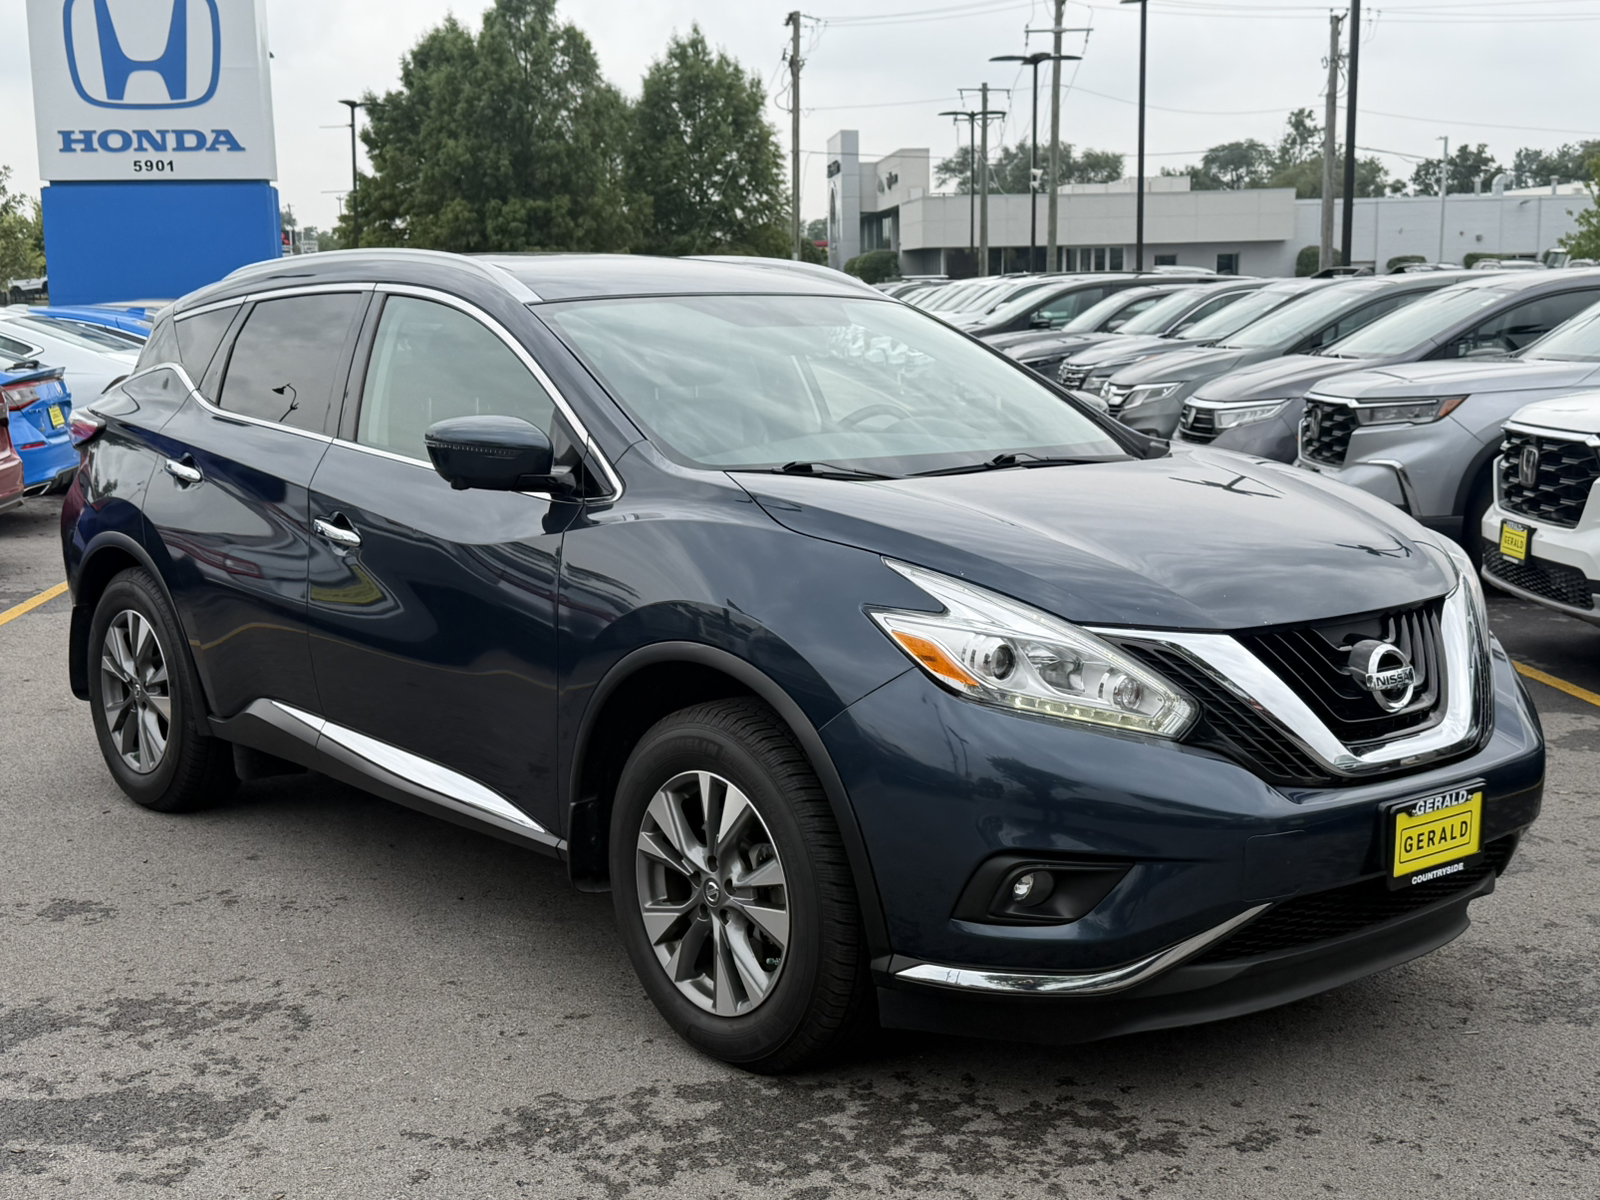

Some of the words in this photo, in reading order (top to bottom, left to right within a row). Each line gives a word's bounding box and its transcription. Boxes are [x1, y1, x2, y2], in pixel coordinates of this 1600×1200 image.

[57, 129, 246, 153] HONDA
[133, 159, 175, 173] 5901
[1416, 790, 1467, 815] GERALD
[1404, 820, 1468, 853] GERALD
[1412, 862, 1464, 885] COUNTRYSIDE
